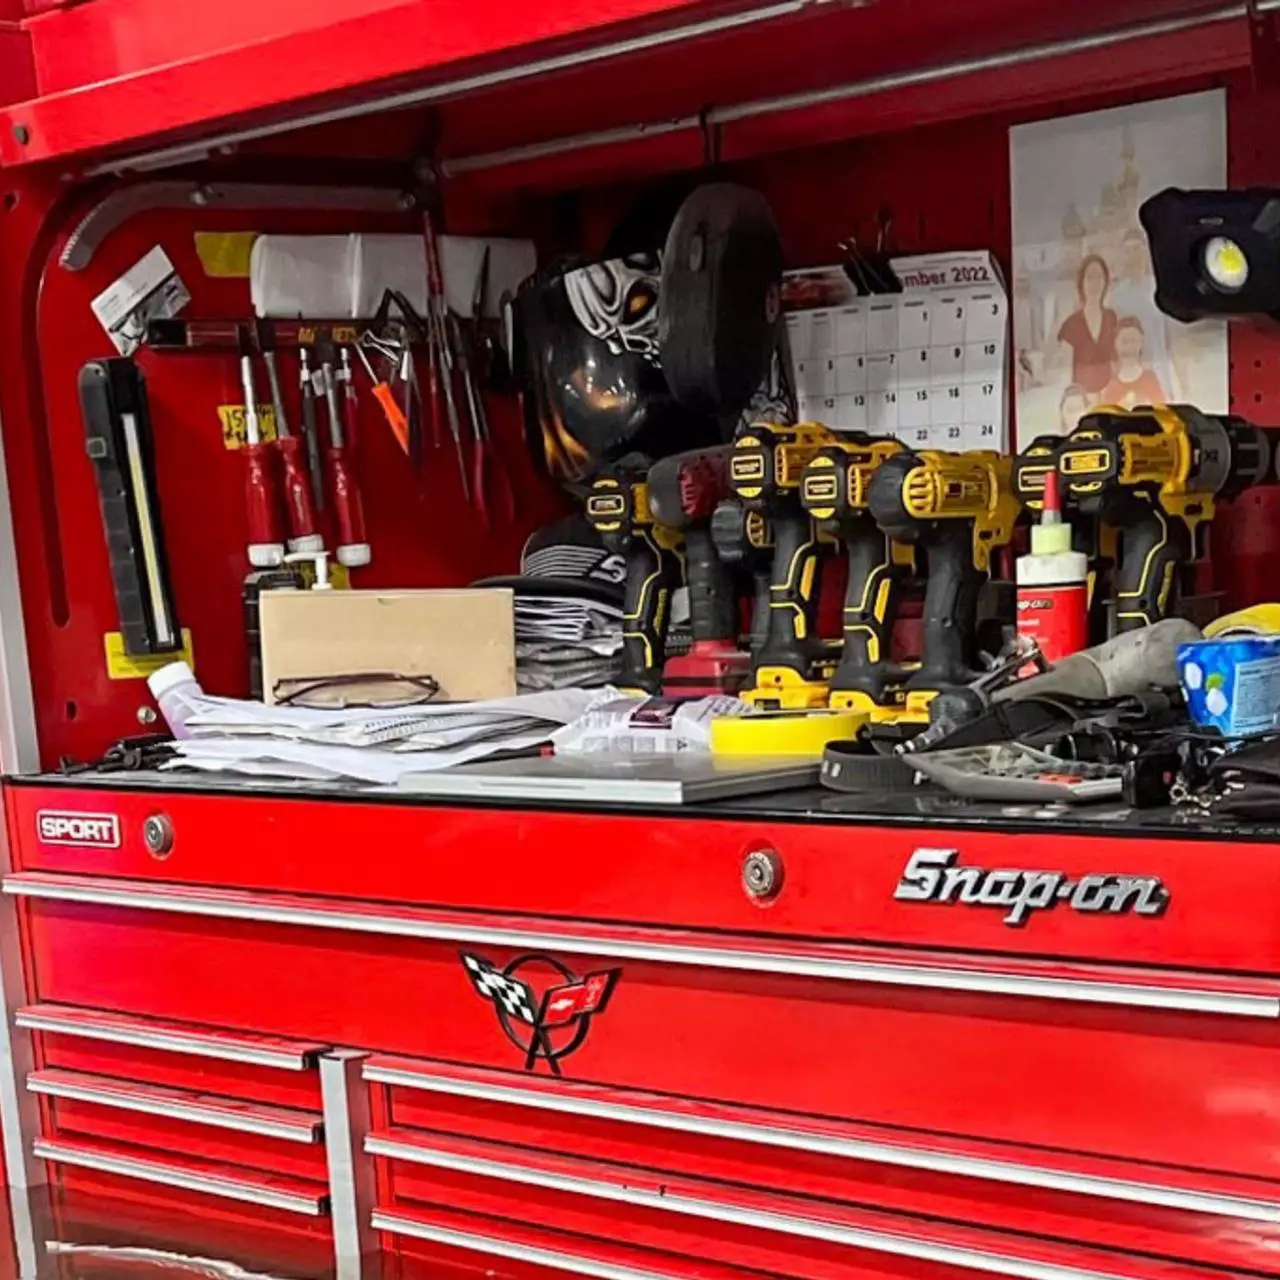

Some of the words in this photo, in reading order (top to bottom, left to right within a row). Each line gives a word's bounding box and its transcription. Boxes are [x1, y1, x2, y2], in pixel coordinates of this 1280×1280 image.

[902, 270, 947, 287] mber
[950, 266, 990, 283] 2022
[984, 344, 996, 355] 10
[854, 394, 865, 406] 13
[885, 392, 896, 404] 14
[916, 390, 928, 401] 15
[949, 387, 960, 399] 16
[982, 383, 994, 396] 17
[916, 429, 928, 441] 22
[948, 427, 960, 438] 23
[981, 424, 993, 436] 24
[41, 816, 112, 841] SPORT
[893, 846, 1168, 926] Snap-on
